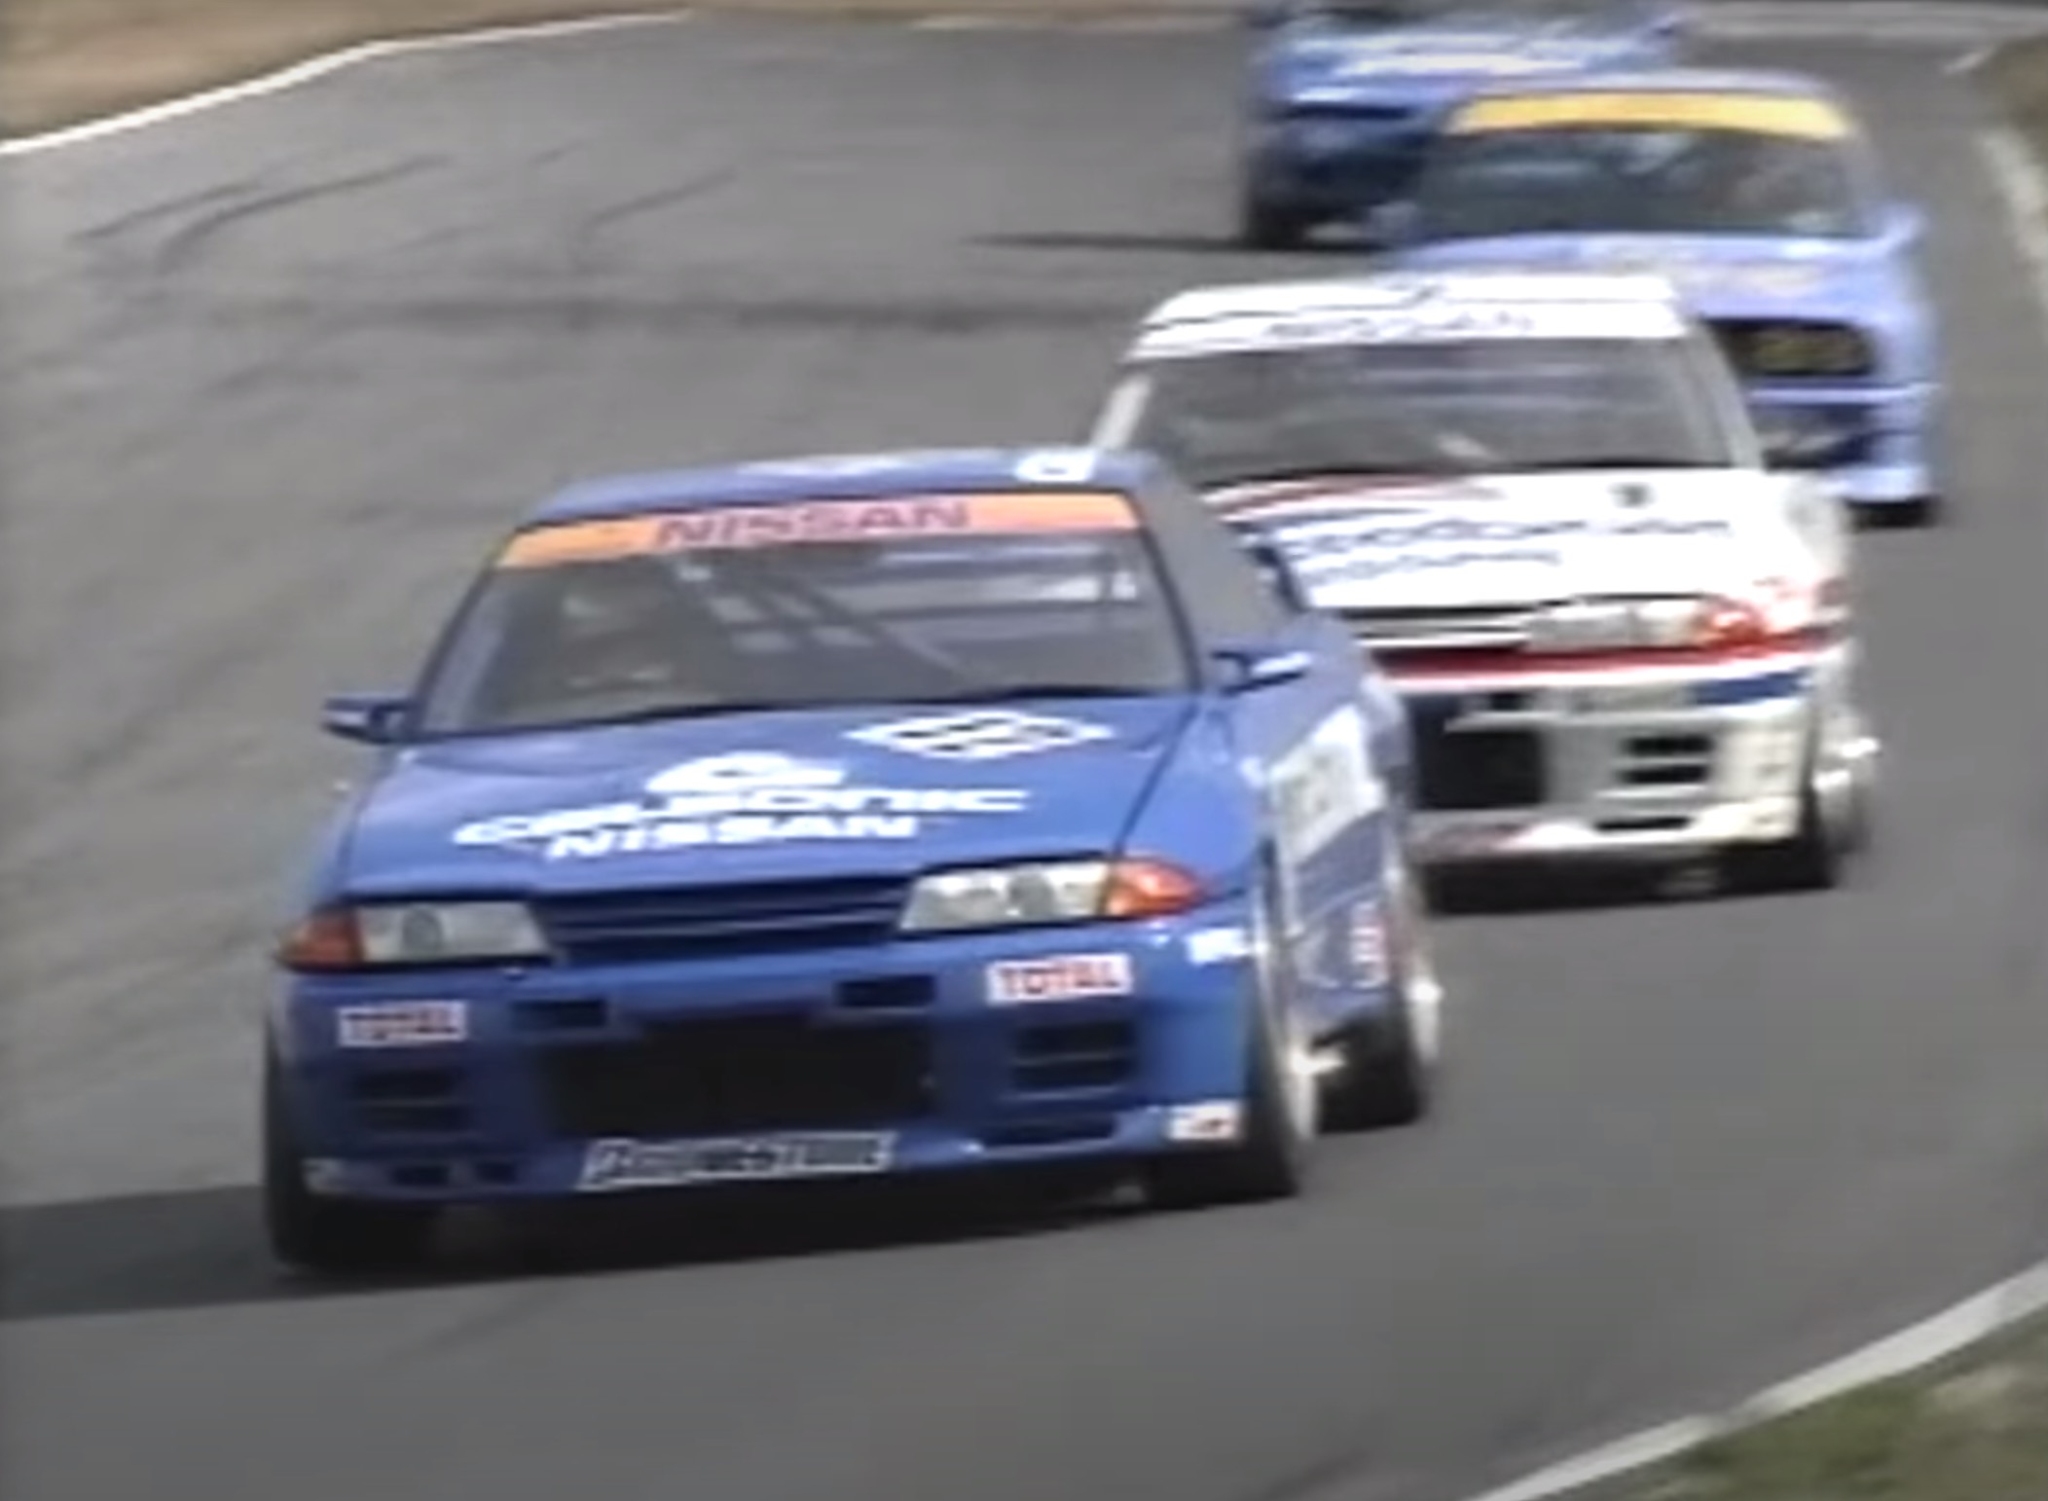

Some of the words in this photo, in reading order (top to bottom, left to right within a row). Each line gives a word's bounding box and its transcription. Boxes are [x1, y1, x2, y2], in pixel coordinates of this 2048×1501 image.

[656, 500, 970, 546] NISSAN
[547, 814, 919, 861] NISSAN
[1000, 960, 1122, 998] TOTAL
